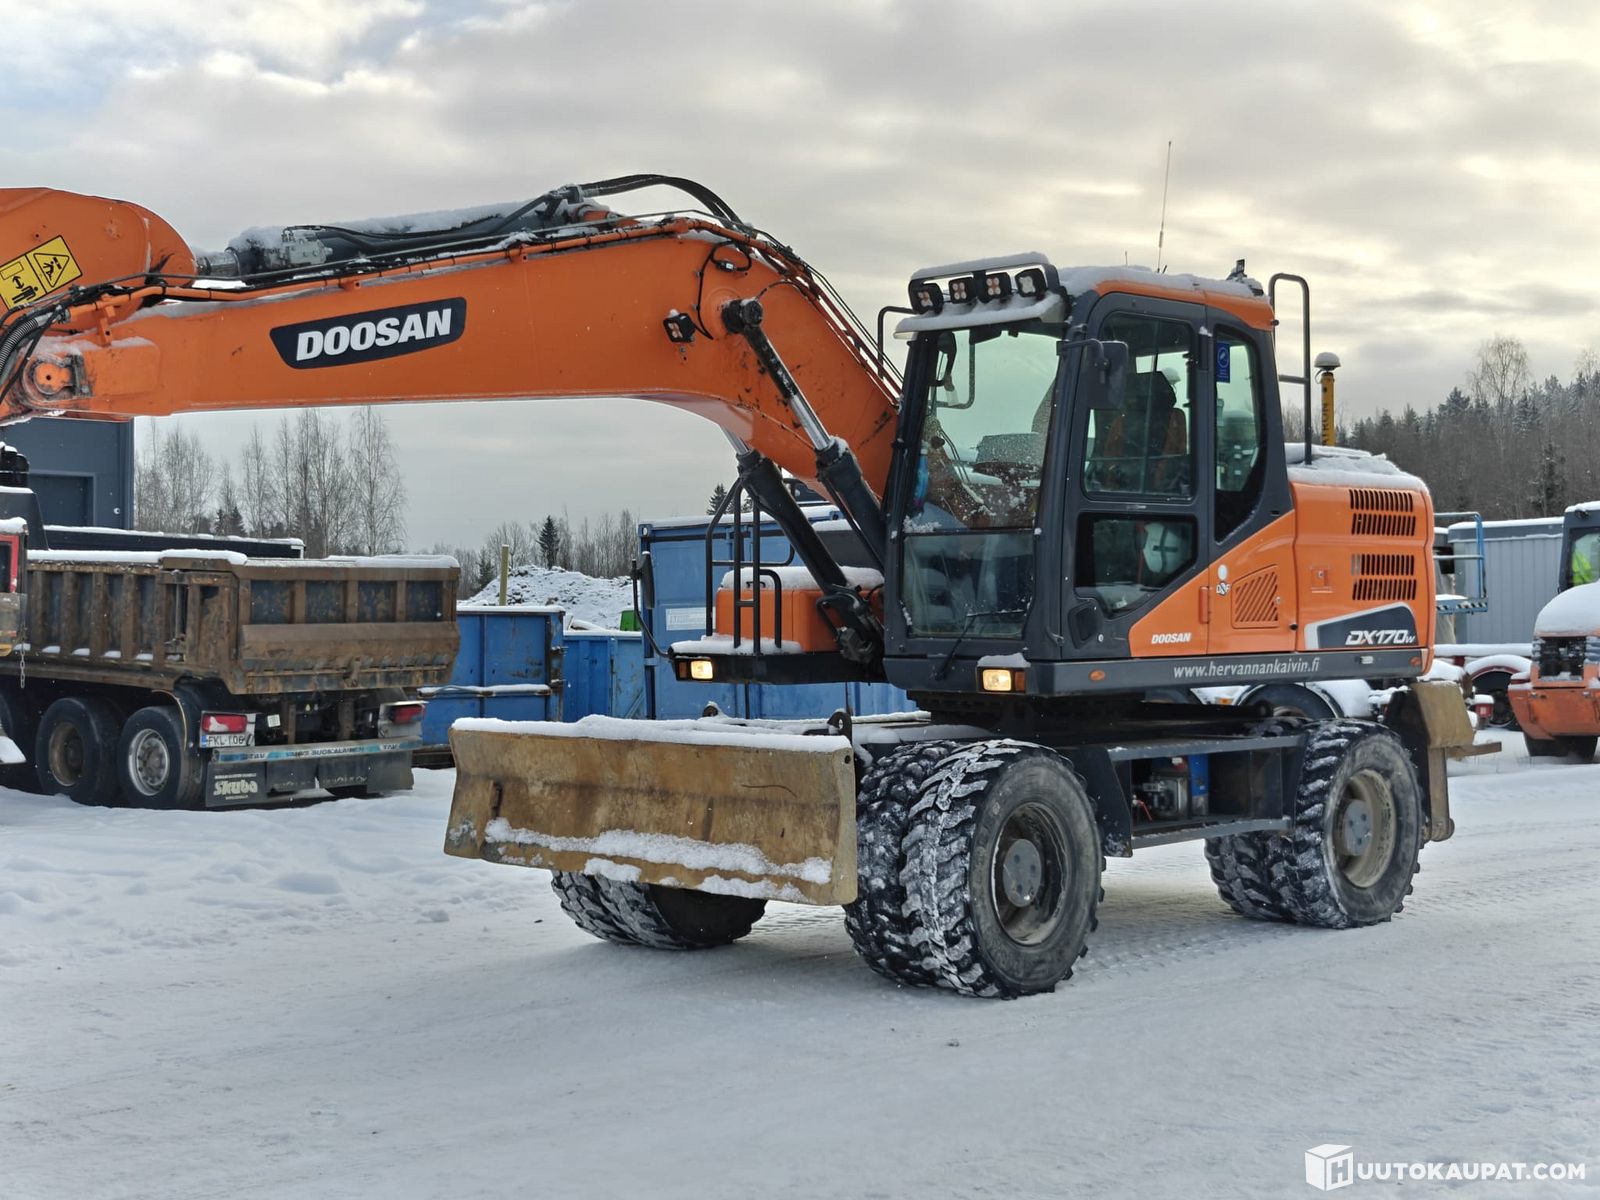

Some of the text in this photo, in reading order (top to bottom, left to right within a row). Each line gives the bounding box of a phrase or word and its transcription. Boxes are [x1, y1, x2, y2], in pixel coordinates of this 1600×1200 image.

[296, 308, 452, 361] DOOSAN
[1151, 632, 1192, 644] DOOSAN
[1173, 657, 1320, 678] www.hervannankaivin.fi
